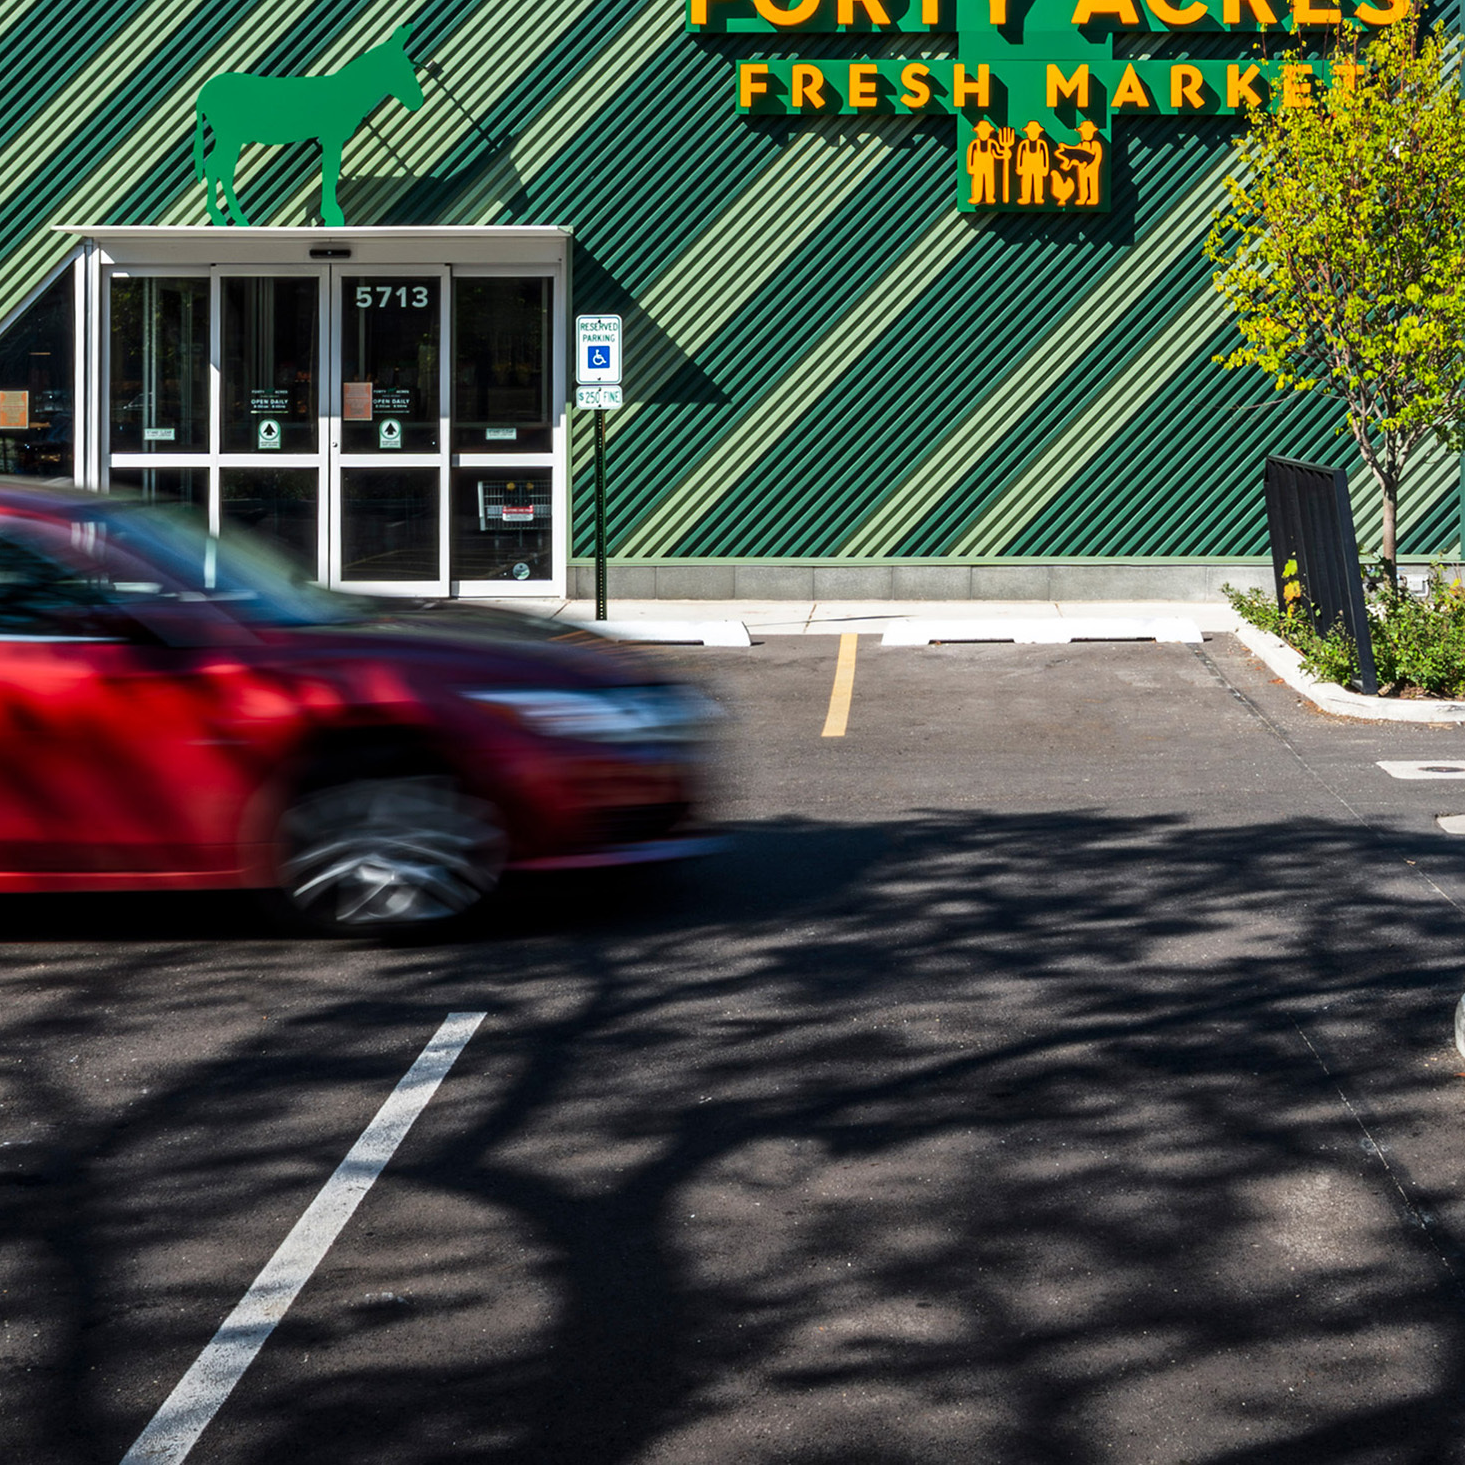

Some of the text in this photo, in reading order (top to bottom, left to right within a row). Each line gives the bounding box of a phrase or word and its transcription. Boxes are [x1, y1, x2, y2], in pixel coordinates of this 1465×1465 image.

[740, 61, 1365, 110] FRESH MARKET
[356, 286, 428, 308] 5713
[580, 323, 618, 331] RESERVED
[582, 334, 615, 342] PARKING
[578, 391, 620, 403] $250 FINE
